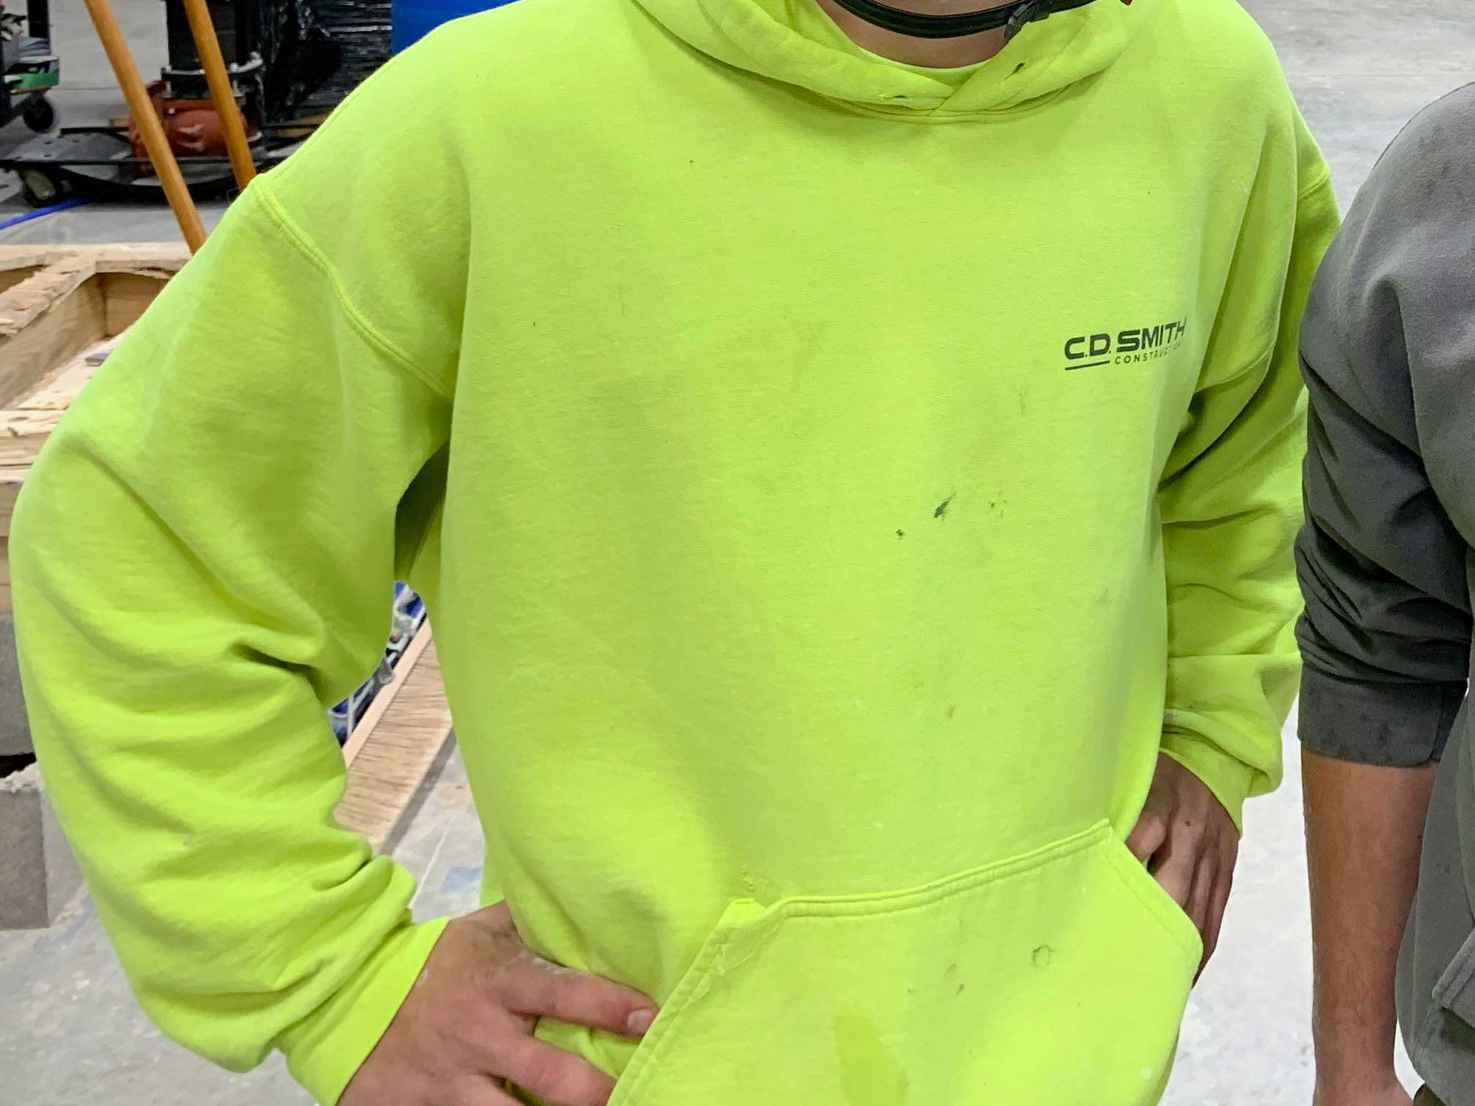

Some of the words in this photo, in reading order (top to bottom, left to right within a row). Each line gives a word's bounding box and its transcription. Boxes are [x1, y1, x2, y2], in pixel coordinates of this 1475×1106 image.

[1064, 333, 1112, 360] C.D.
[1116, 317, 1187, 353] SMITH
[1115, 342, 1182, 365] CONSTRUC
